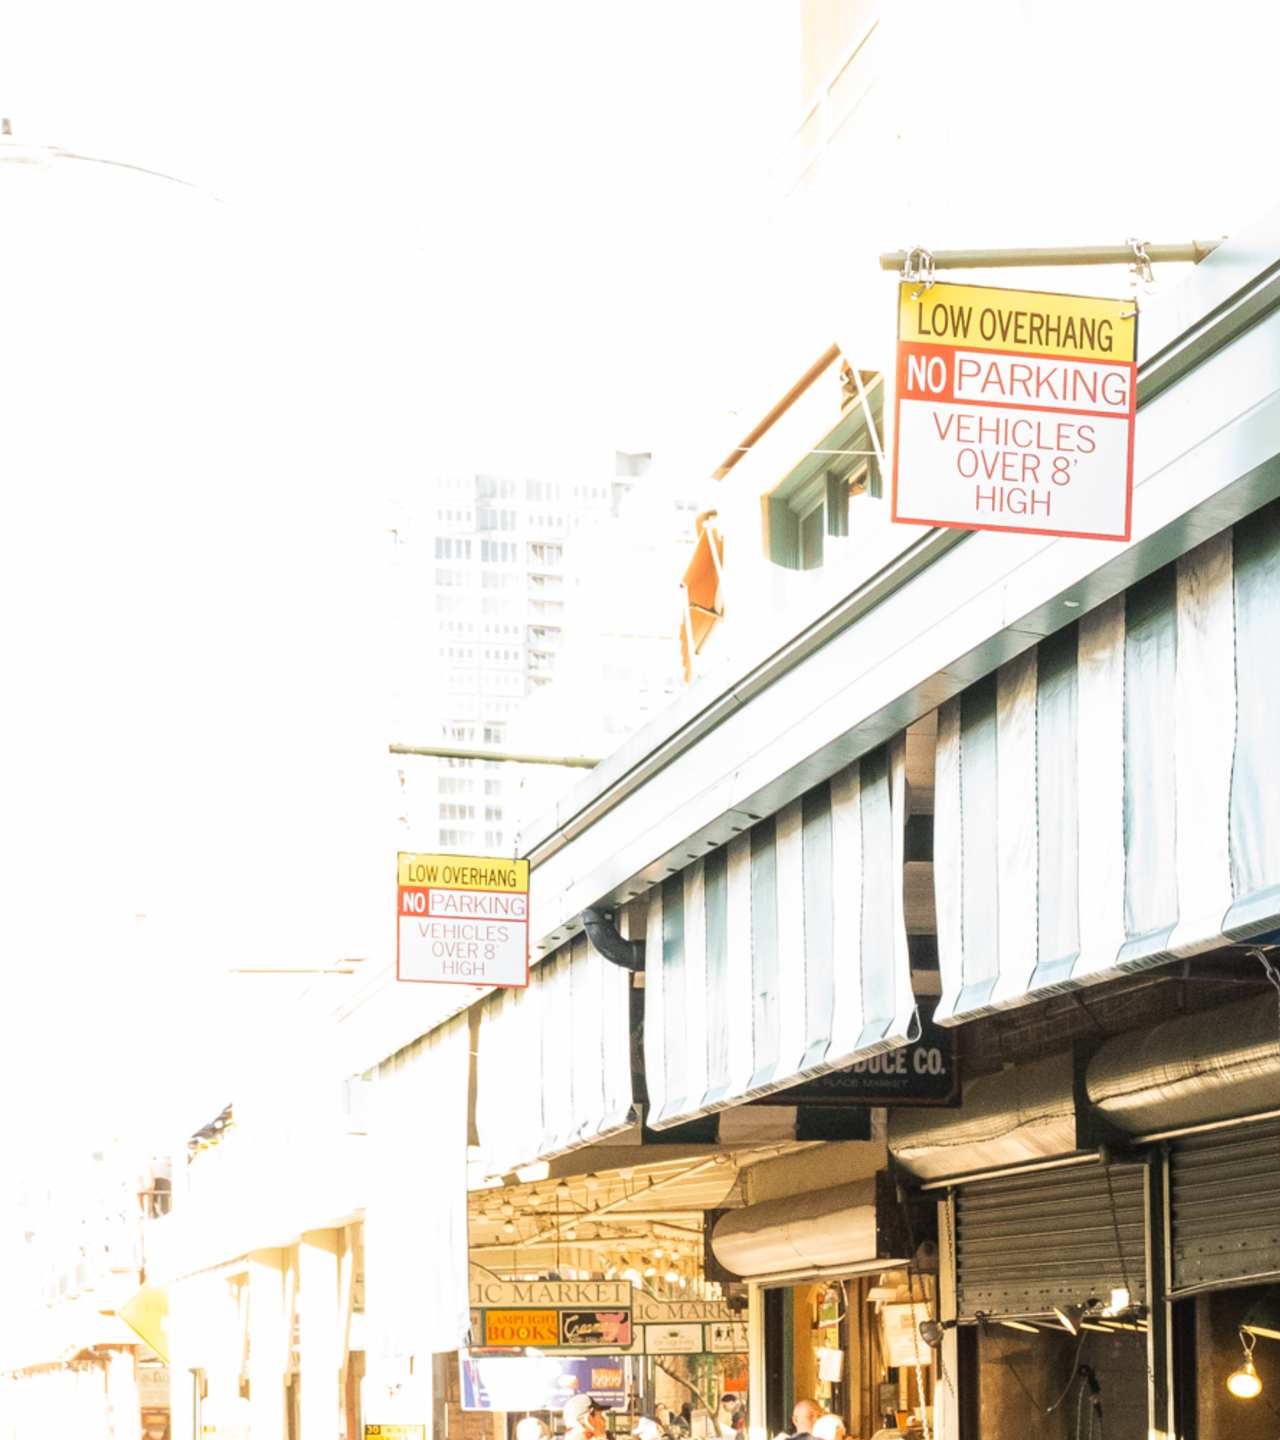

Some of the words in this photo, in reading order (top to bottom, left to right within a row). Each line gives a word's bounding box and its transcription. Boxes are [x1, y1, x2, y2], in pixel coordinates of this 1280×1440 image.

[917, 301, 974, 339] LOW
[979, 307, 1114, 353] OVERHANG
[906, 353, 947, 393] NO
[957, 358, 1127, 407] PARKING
[932, 411, 1097, 454] VEHICLES
[956, 448, 1041, 484] OVER
[975, 484, 1052, 517] HIGH
[407, 863, 439, 883] LOW
[441, 865, 518, 888] OVERHANG
[402, 891, 427, 913] NO
[430, 893, 527, 917] PARKING
[417, 921, 511, 943] VEHICLES
[430, 940, 480, 960] OVER
[441, 959, 486, 977] HIGH
[912, 1046, 947, 1076] CO.
[512, 1283, 626, 1304] MARKET
[487, 1314, 558, 1326] LAMPLIGHT
[666, 1303, 732, 1321] MARK
[487, 1325, 558, 1341] BOOKS
